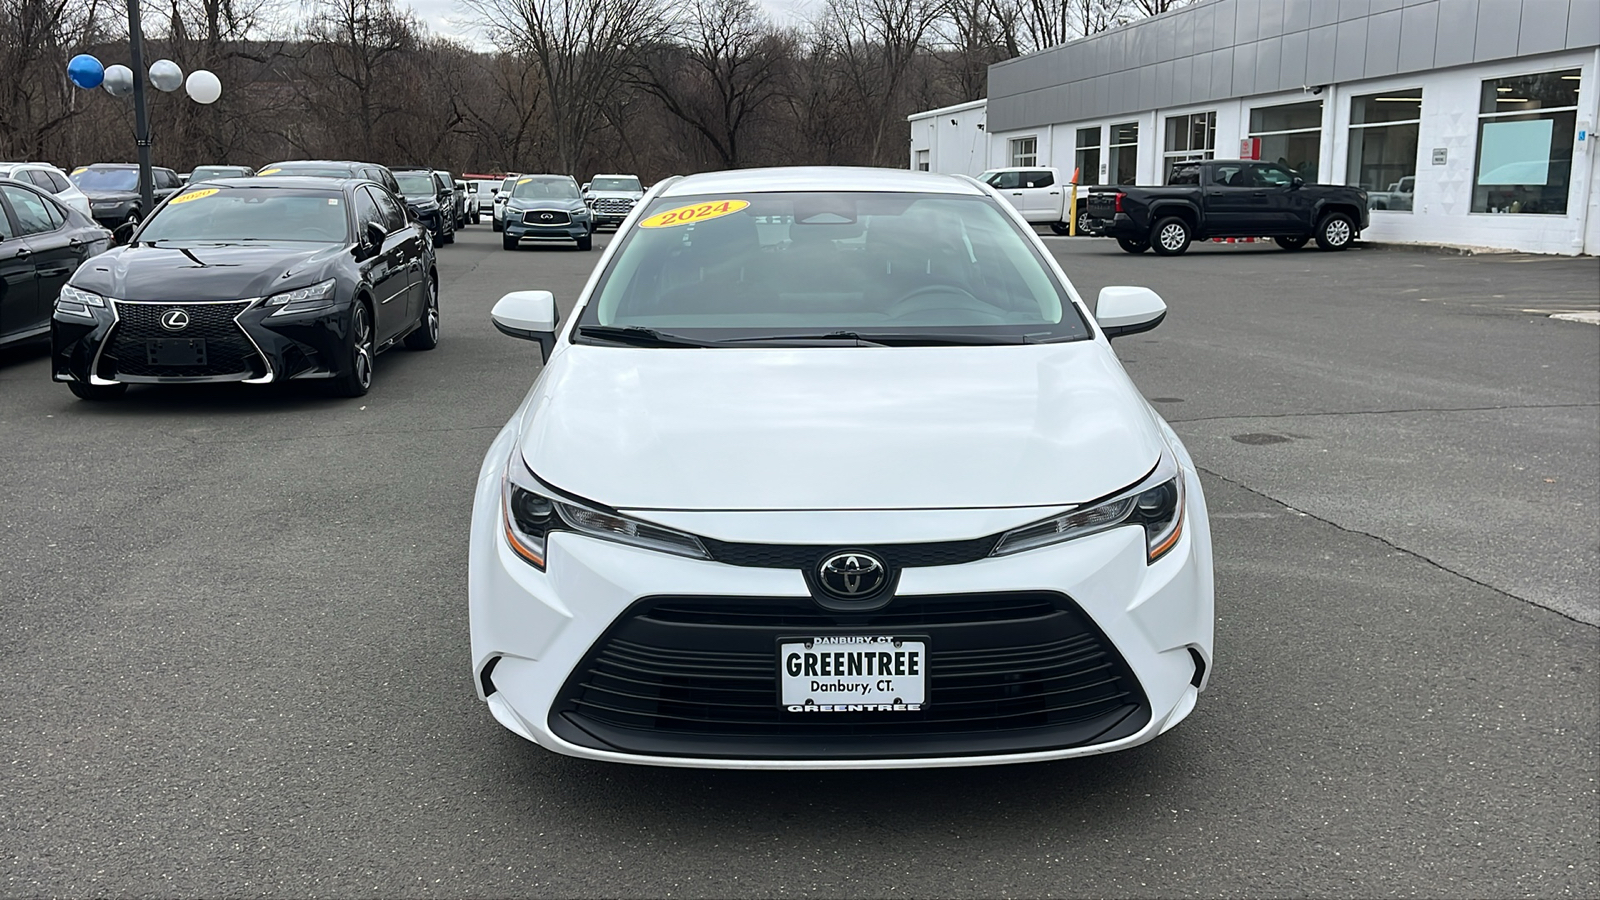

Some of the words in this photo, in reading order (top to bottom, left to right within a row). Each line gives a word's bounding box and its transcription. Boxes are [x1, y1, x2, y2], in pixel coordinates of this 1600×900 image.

[178, 190, 211, 203] 2020
[660, 201, 732, 226] 2024
[813, 636, 874, 646] DANBURY,
[877, 636, 894, 644] CT
[786, 651, 919, 677] GREENTREE
[811, 679, 872, 696] Danbury,
[876, 680, 895, 692] CT.
[787, 704, 921, 713] GREENTREE
